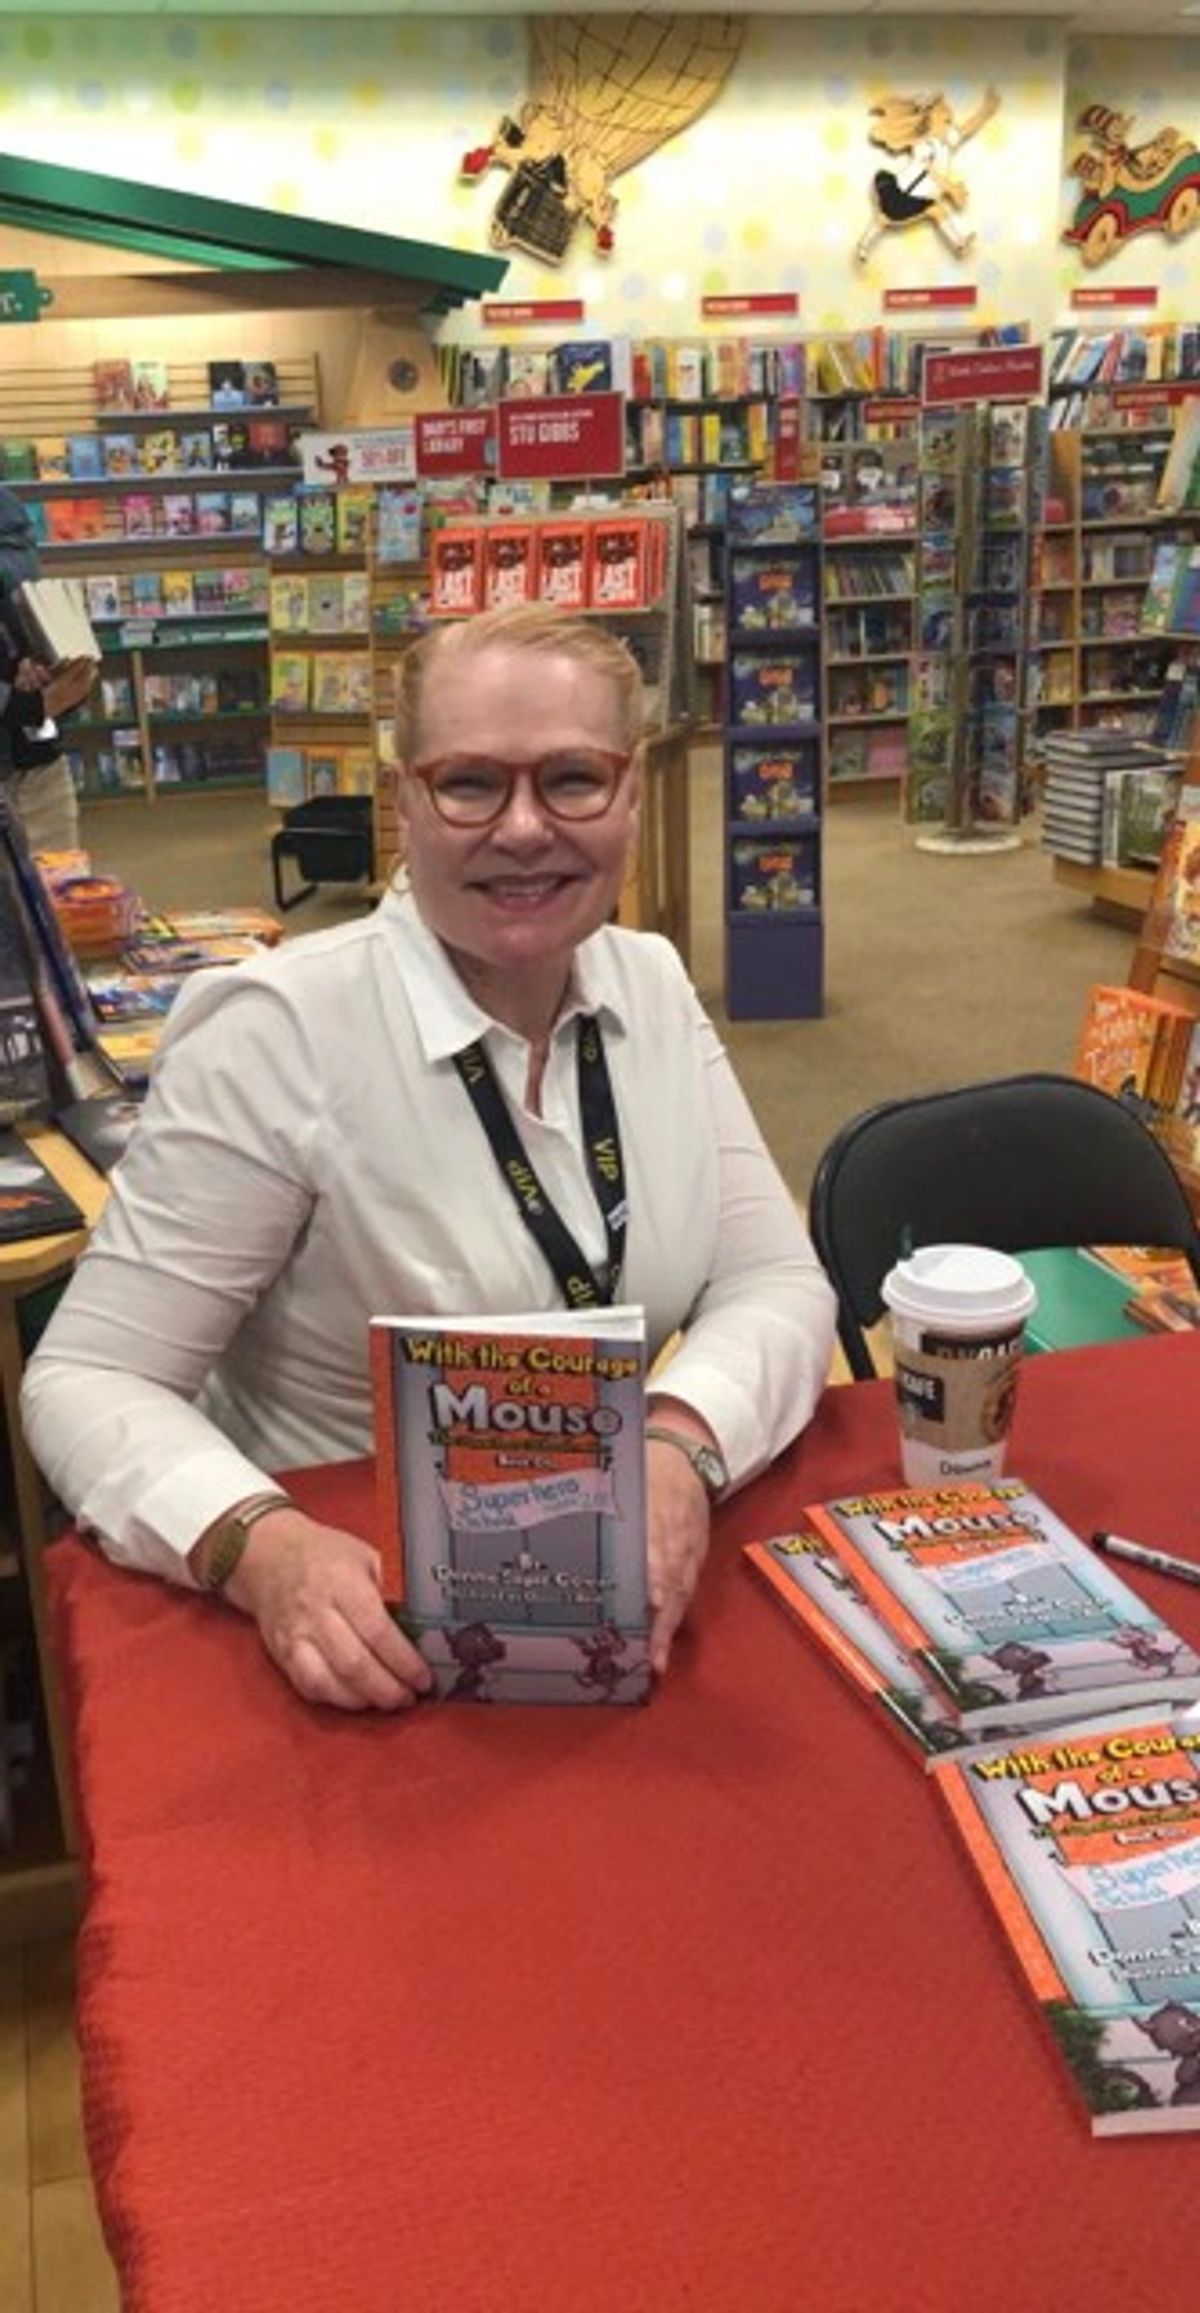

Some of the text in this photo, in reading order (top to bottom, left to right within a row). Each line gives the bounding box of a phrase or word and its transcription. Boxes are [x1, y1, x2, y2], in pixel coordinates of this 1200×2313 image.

[506, 1160, 544, 1204] VIP
[595, 1138, 621, 1182] VIP
[405, 1335, 639, 1379] With the Courage
[428, 1382, 622, 1437] Mouse
[873, 1513, 1040, 1543] Mouse
[972, 1753, 1048, 1781] With
[1051, 1749, 1100, 1770] the
